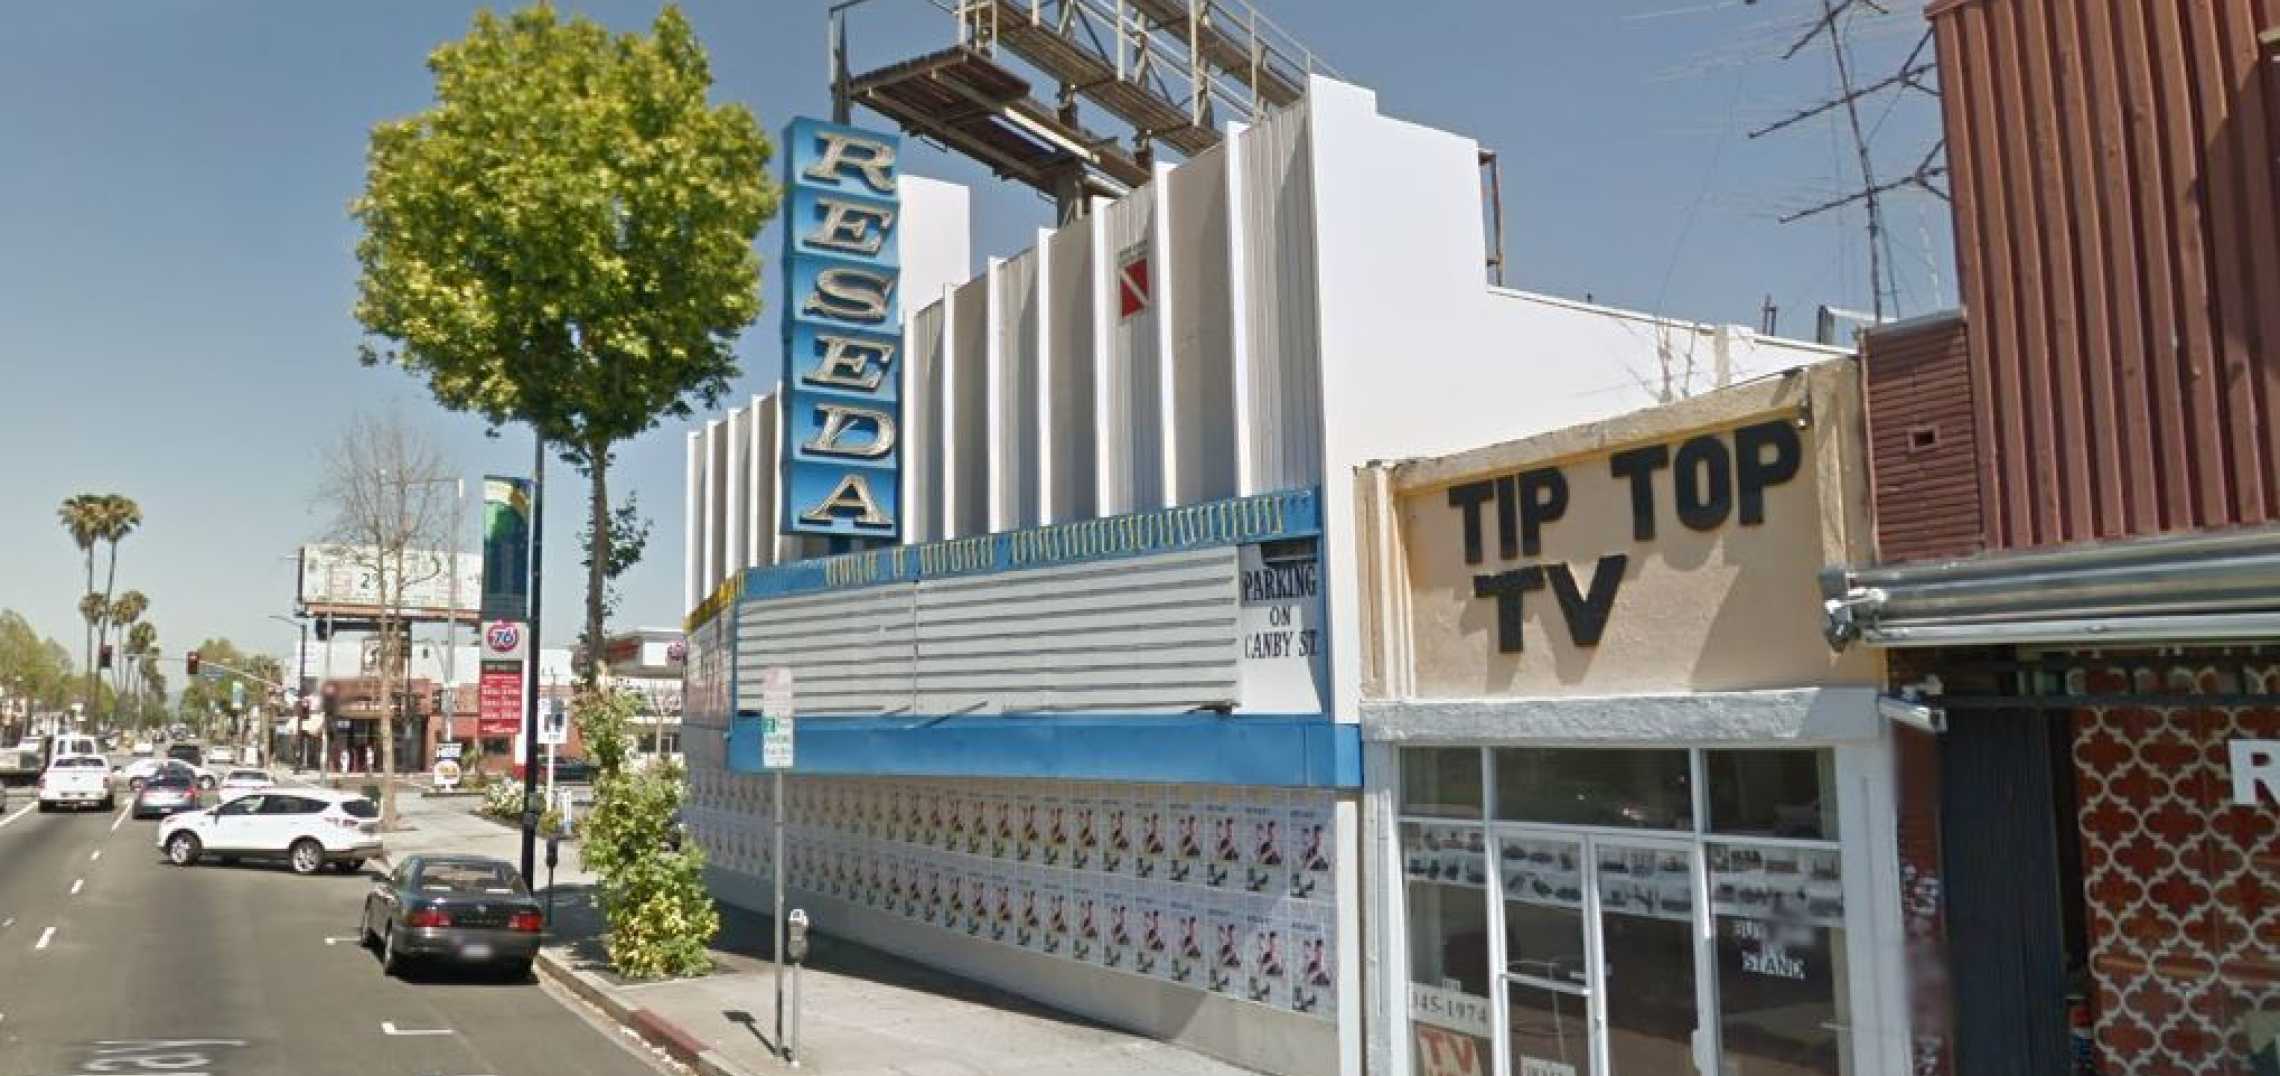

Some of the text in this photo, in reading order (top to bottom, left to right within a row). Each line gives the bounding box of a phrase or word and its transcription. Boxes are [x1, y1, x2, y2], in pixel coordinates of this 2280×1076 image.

[799, 132, 897, 529] RESEDA
[1448, 418, 1803, 565] TIP TOP
[1242, 564, 1316, 601] PARKING
[1473, 554, 1628, 654] TV
[1269, 604, 1292, 627] ON
[1244, 630, 1294, 660] CANBY
[1422, 1029, 1474, 1074] TV
